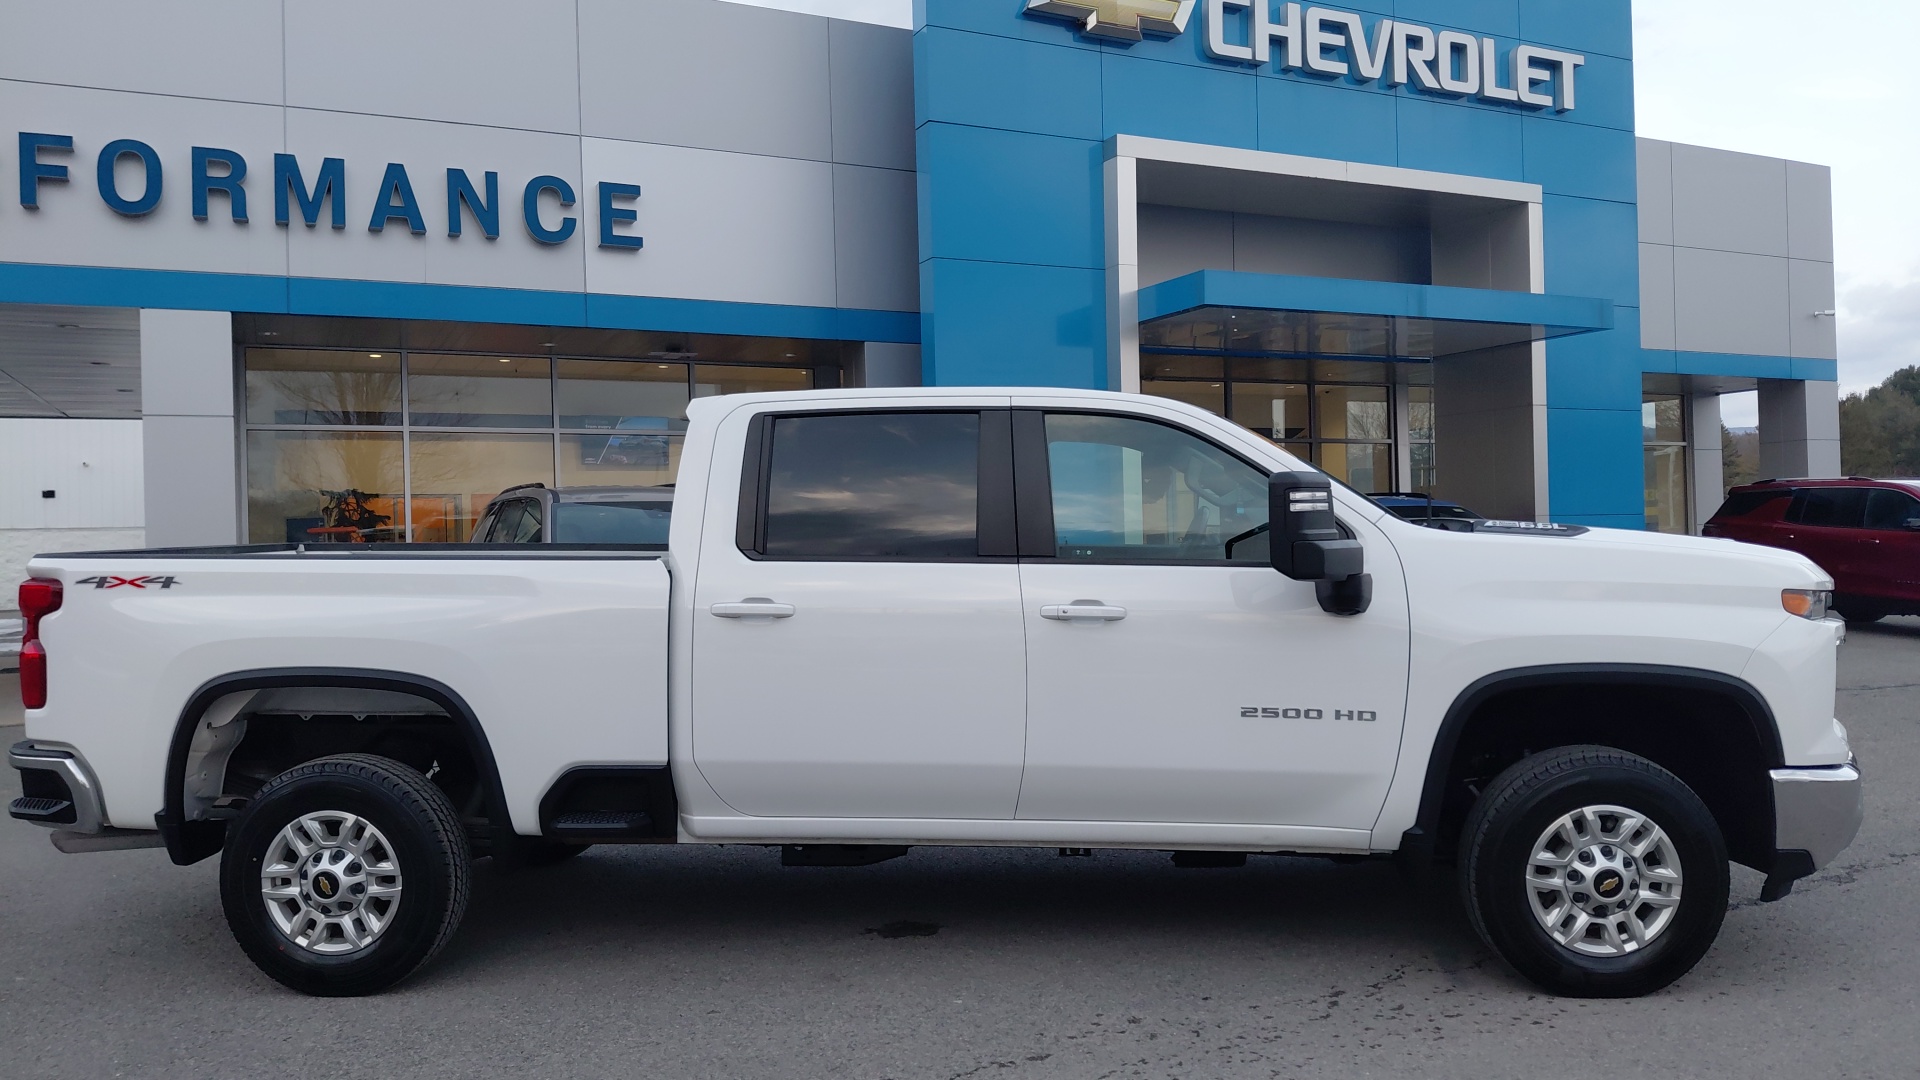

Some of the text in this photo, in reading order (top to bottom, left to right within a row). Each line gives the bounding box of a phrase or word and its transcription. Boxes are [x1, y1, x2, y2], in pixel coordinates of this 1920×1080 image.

[1206, 0, 1584, 112] CHEVROLET
[1240, 706, 1377, 722] 2500 HD
